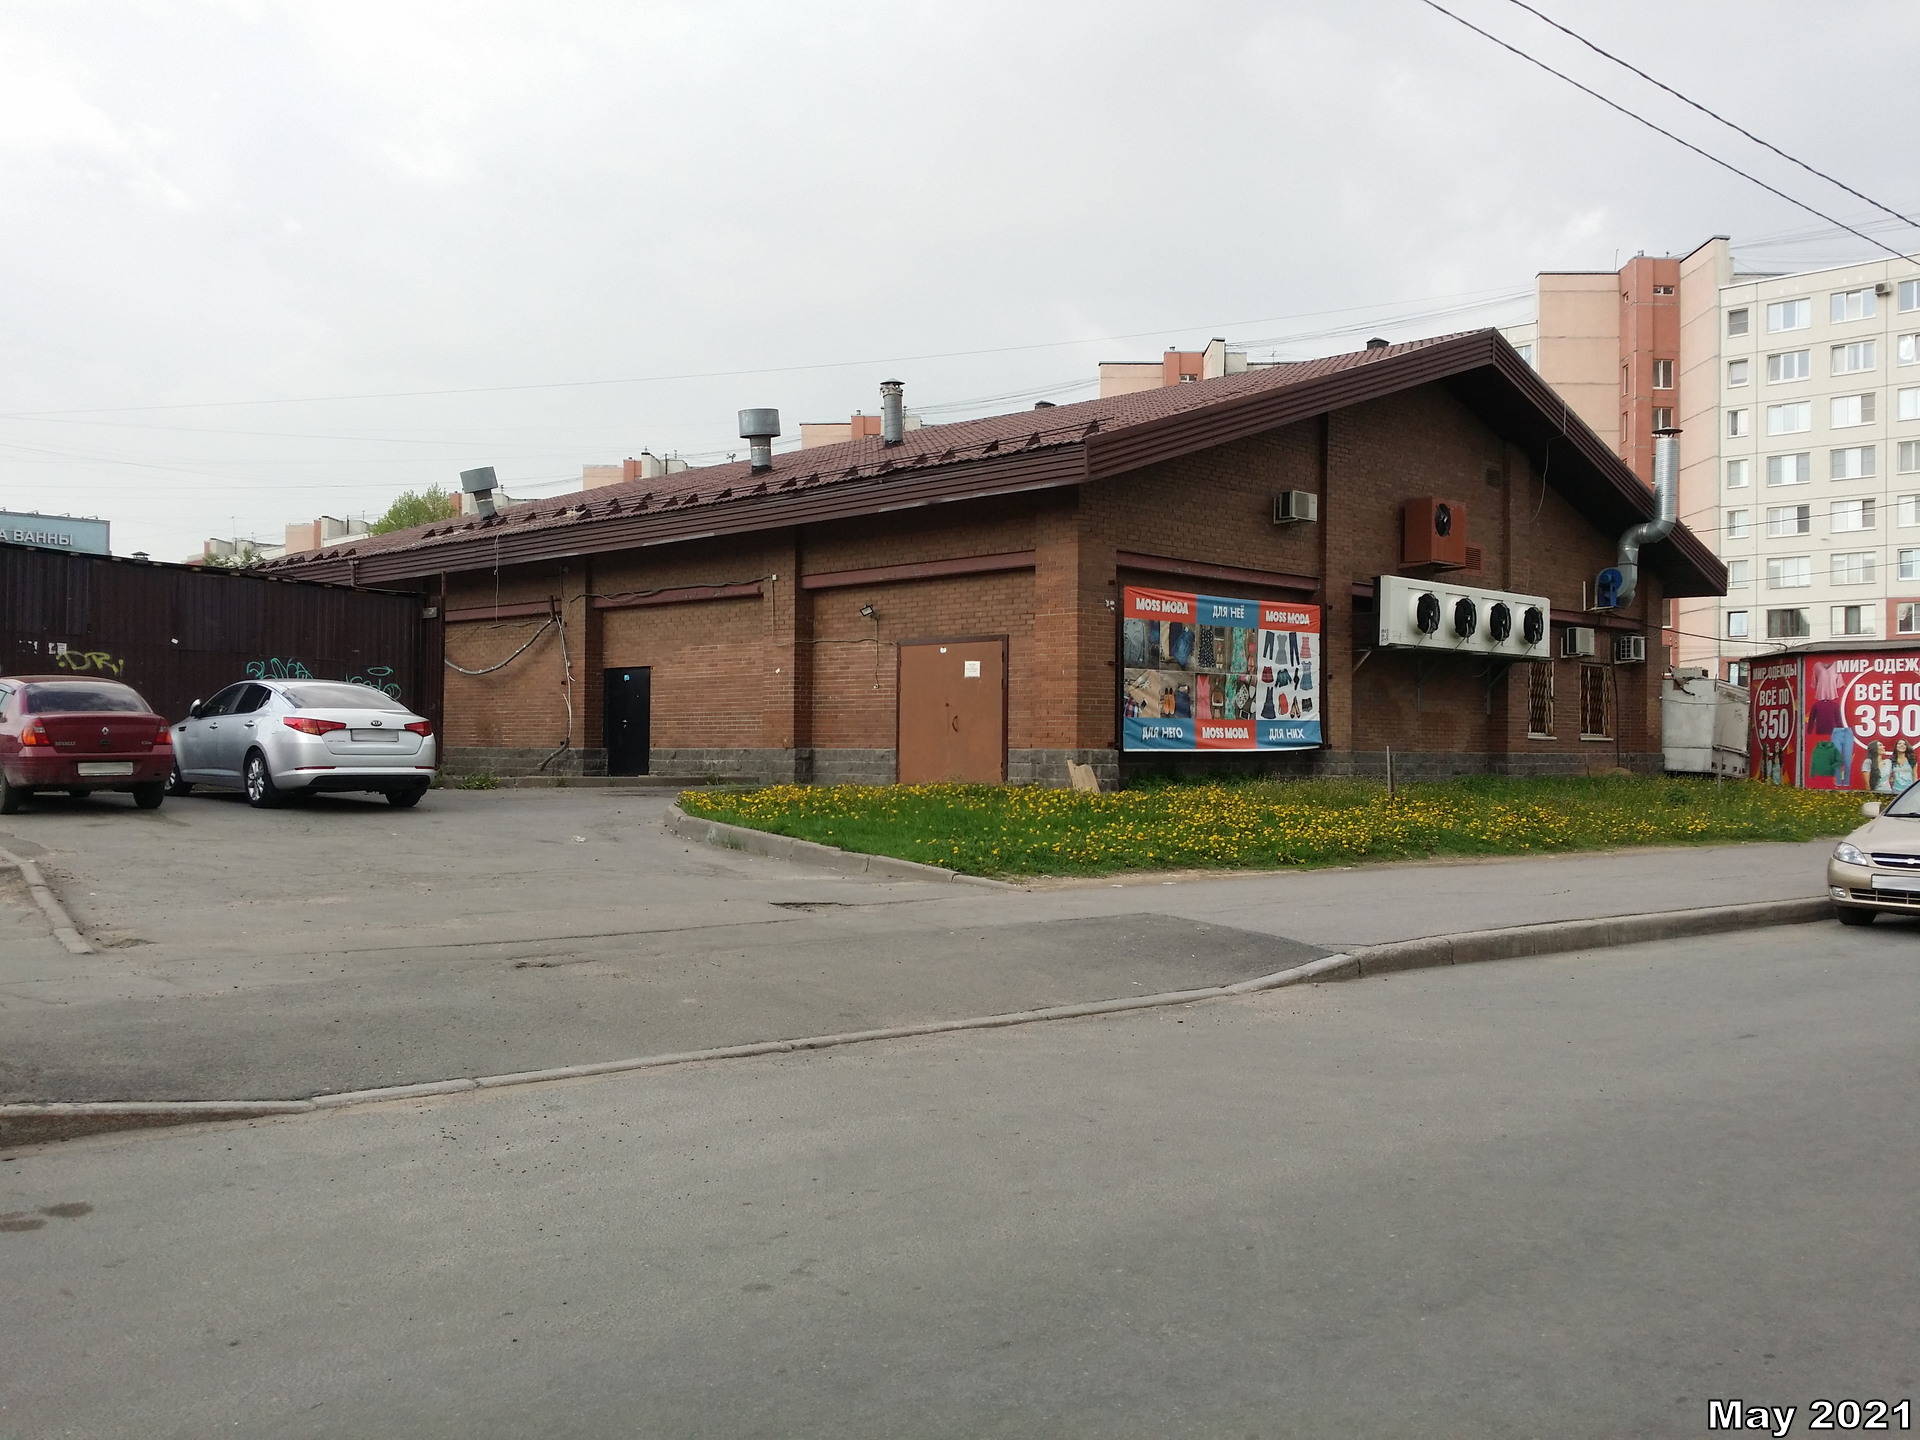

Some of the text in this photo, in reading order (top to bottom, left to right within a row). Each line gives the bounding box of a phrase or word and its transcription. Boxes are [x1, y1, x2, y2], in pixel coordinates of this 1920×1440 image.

[13, 529, 73, 546] ВАННЫ
[1136, 597, 1189, 615] MOSS MODA
[1212, 604, 1245, 619] ДЛЯ НЕЁ
[1265, 610, 1310, 625] MOSS MODA
[1752, 663, 1797, 681] МИР ОДЕЖДЫ
[1836, 659, 1870, 673] МИР
[1759, 686, 1790, 706] ВСЁ ПО
[1855, 680, 1894, 701] ВСЁ
[1758, 708, 1789, 740] 350
[1854, 704, 1920, 737] 350
[1142, 726, 1184, 740] ДЛЯ НЕГО
[1201, 727, 1249, 740] MOSS MODA
[1268, 728, 1305, 741] ДЛЯ НИХ
